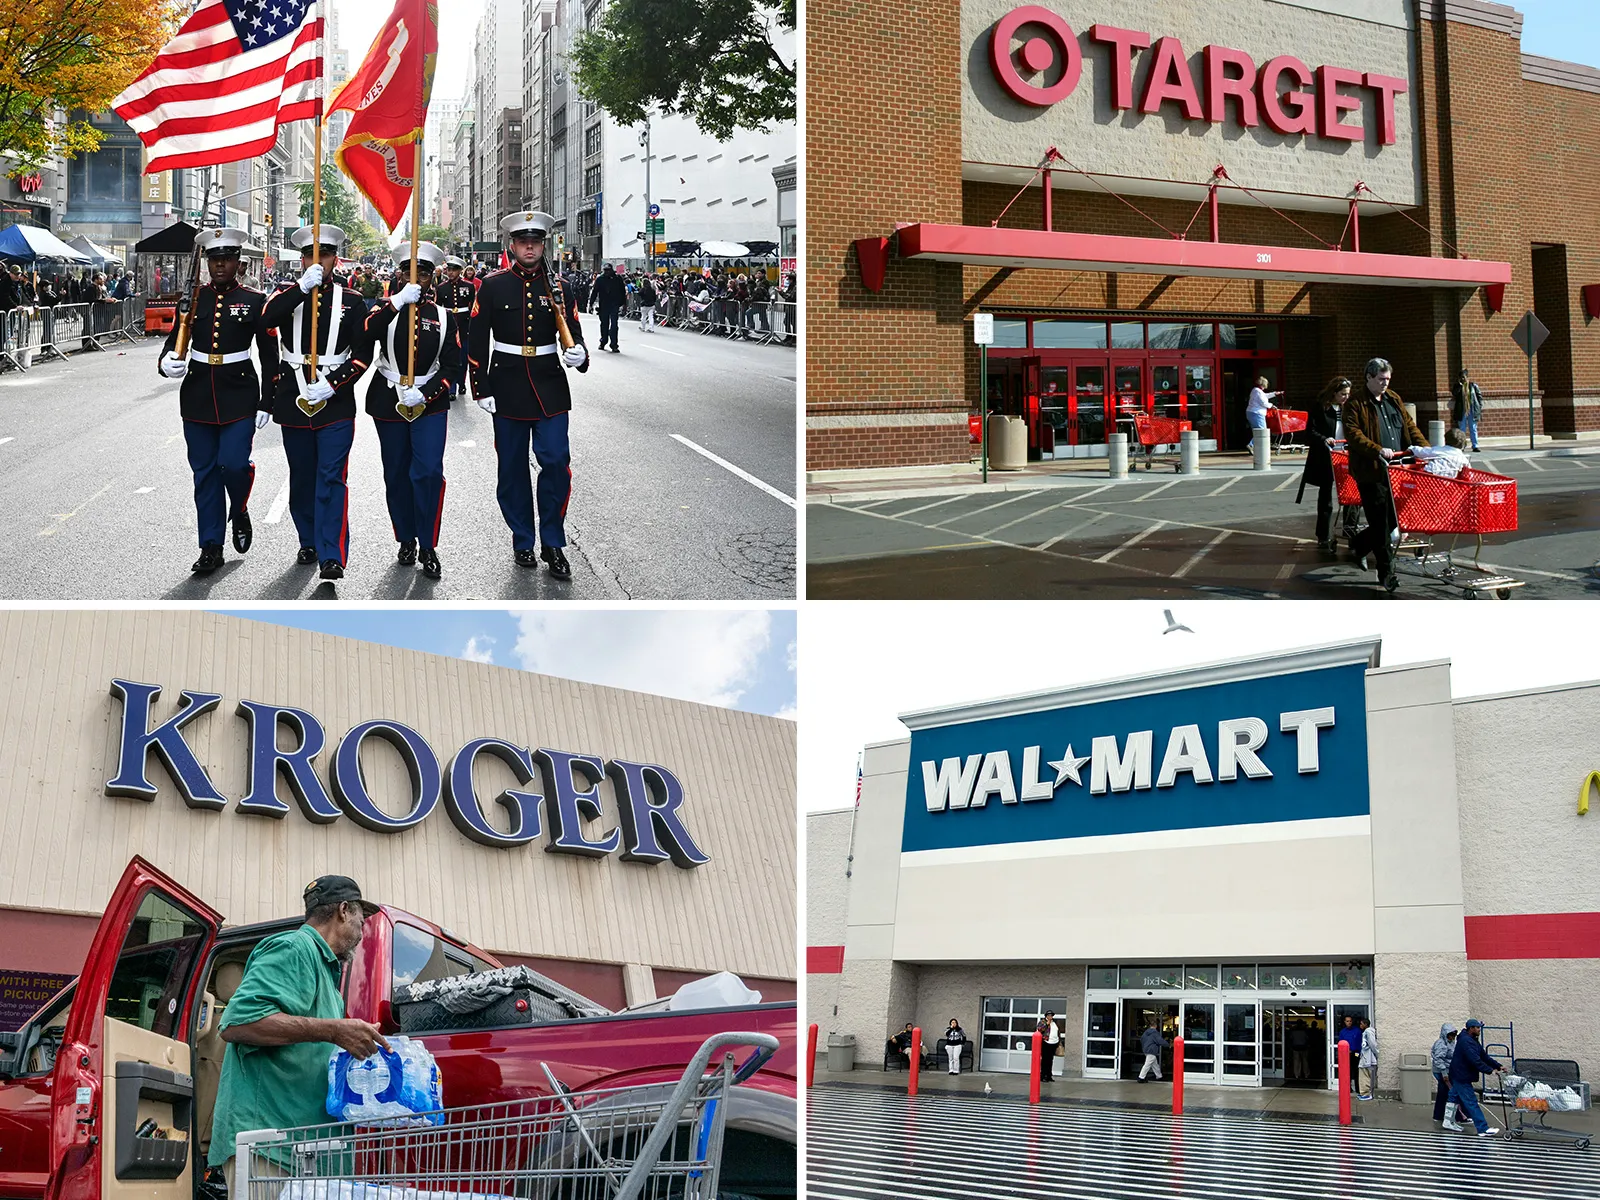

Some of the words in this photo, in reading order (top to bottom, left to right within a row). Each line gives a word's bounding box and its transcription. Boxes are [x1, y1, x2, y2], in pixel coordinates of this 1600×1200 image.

[1089, 24, 1408, 146] TARGET
[386, 155, 412, 187] MARINES
[1256, 252, 1272, 263] 3101
[104, 678, 711, 870] KROGER
[0, 976, 29, 987] WITH
[33, 978, 64, 989] FREE
[1280, 975, 1308, 986] Enter
